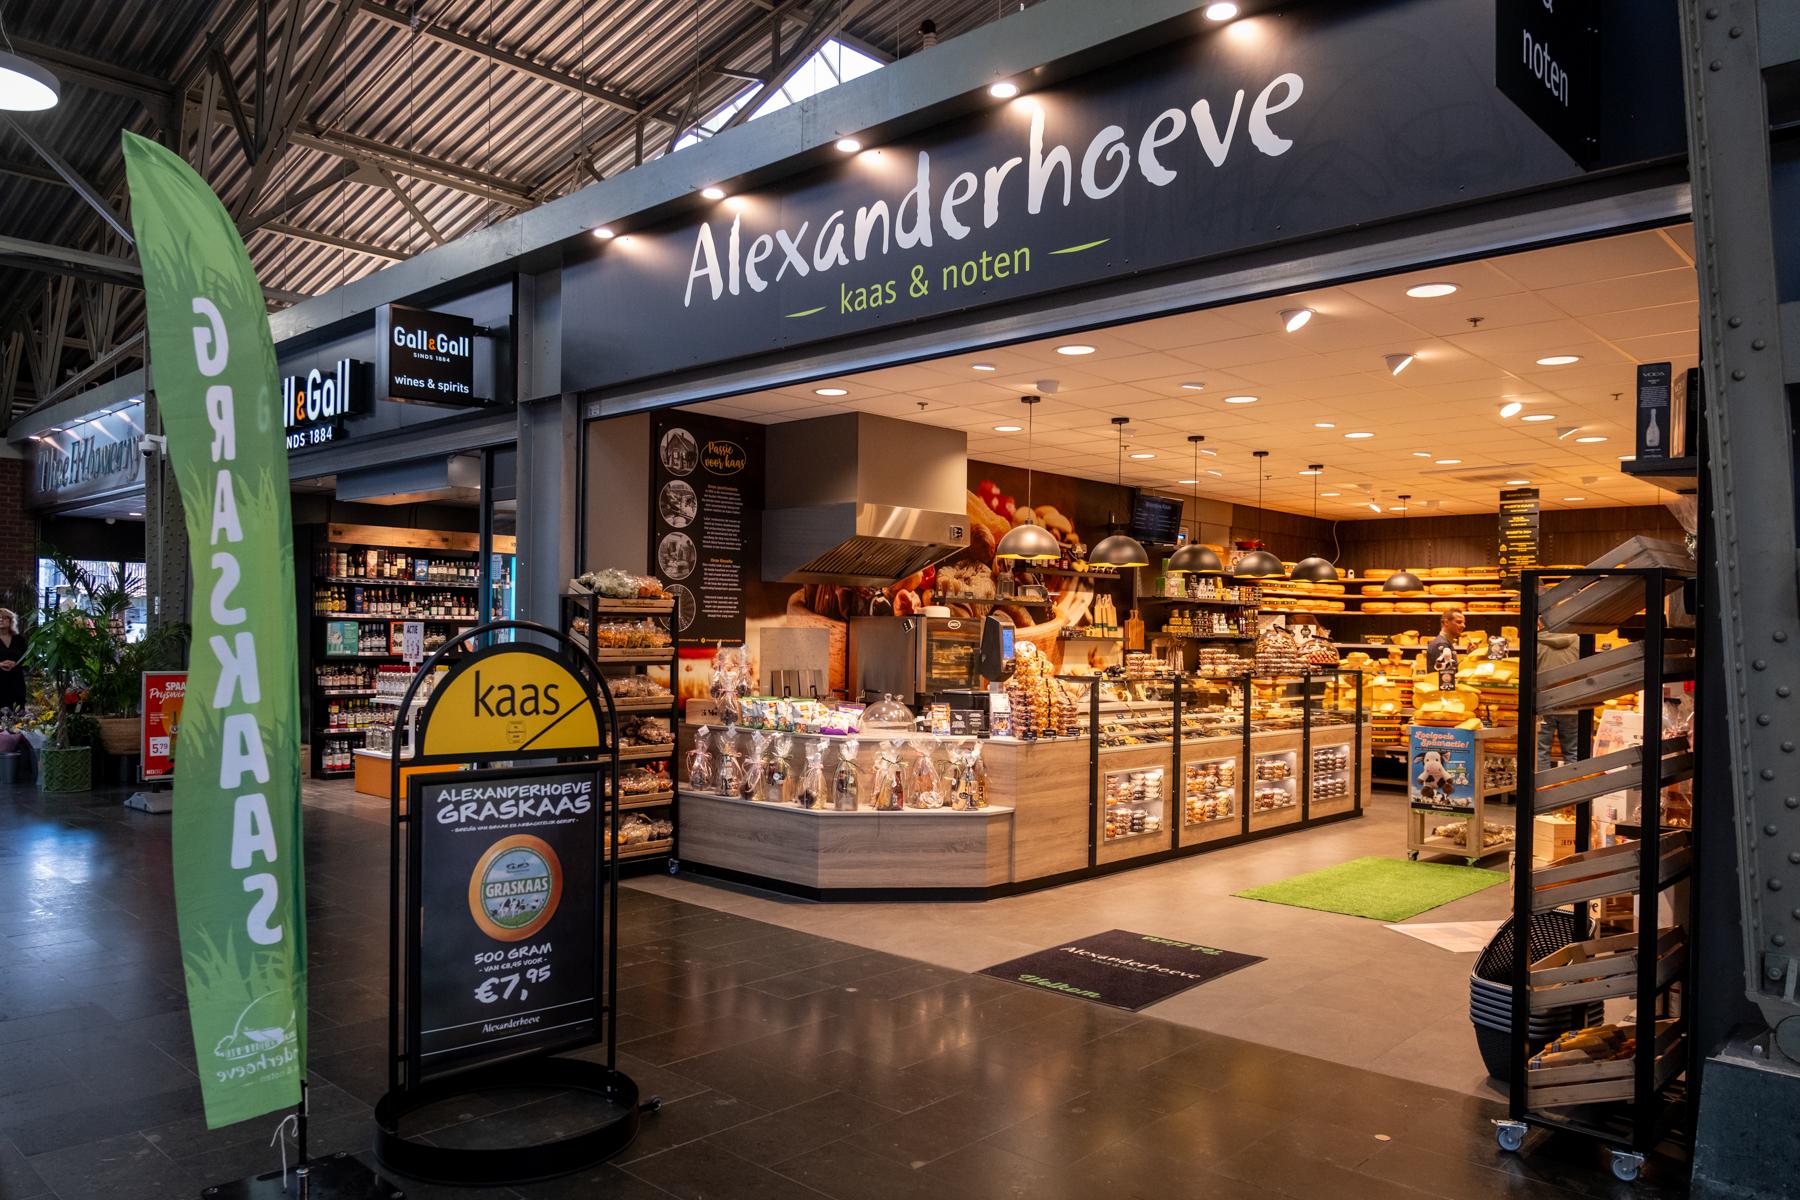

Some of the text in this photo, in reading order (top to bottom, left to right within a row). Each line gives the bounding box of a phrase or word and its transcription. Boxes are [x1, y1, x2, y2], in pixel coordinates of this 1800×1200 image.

[1523, 29, 1569, 107] noten
[684, 73, 1305, 307] Alexanderhoeve
[840, 242, 1031, 315] kaas & noten
[394, 326, 469, 357] Gall&Gall
[413, 352, 450, 363] SINDS 1884
[283, 358, 350, 428] ll&Gall
[394, 375, 469, 394] wines & spirits
[286, 426, 332, 449] NDS 1884
[707, 441, 733, 455] Passie
[704, 455, 745, 470] voor kaas
[406, 624, 419, 634] ACTIE
[165, 682, 186, 691] SPAA
[474, 670, 560, 717] kaas
[437, 781, 592, 803] ALEXANDERHOEVE
[437, 795, 591, 824] GRASKAAS
[486, 877, 548, 898] GRASKAAS
[474, 943, 552, 965] 500 GRAM
[483, 964, 500, 973] VAN
[523, 957, 543, 966] VOOR
[1059, 945, 1201, 979] Alexanderhoeve
[474, 965, 551, 1003] €7,95
[1018, 974, 1101, 998] Welkom
[482, 1015, 541, 1033] Alexanderhoeve
